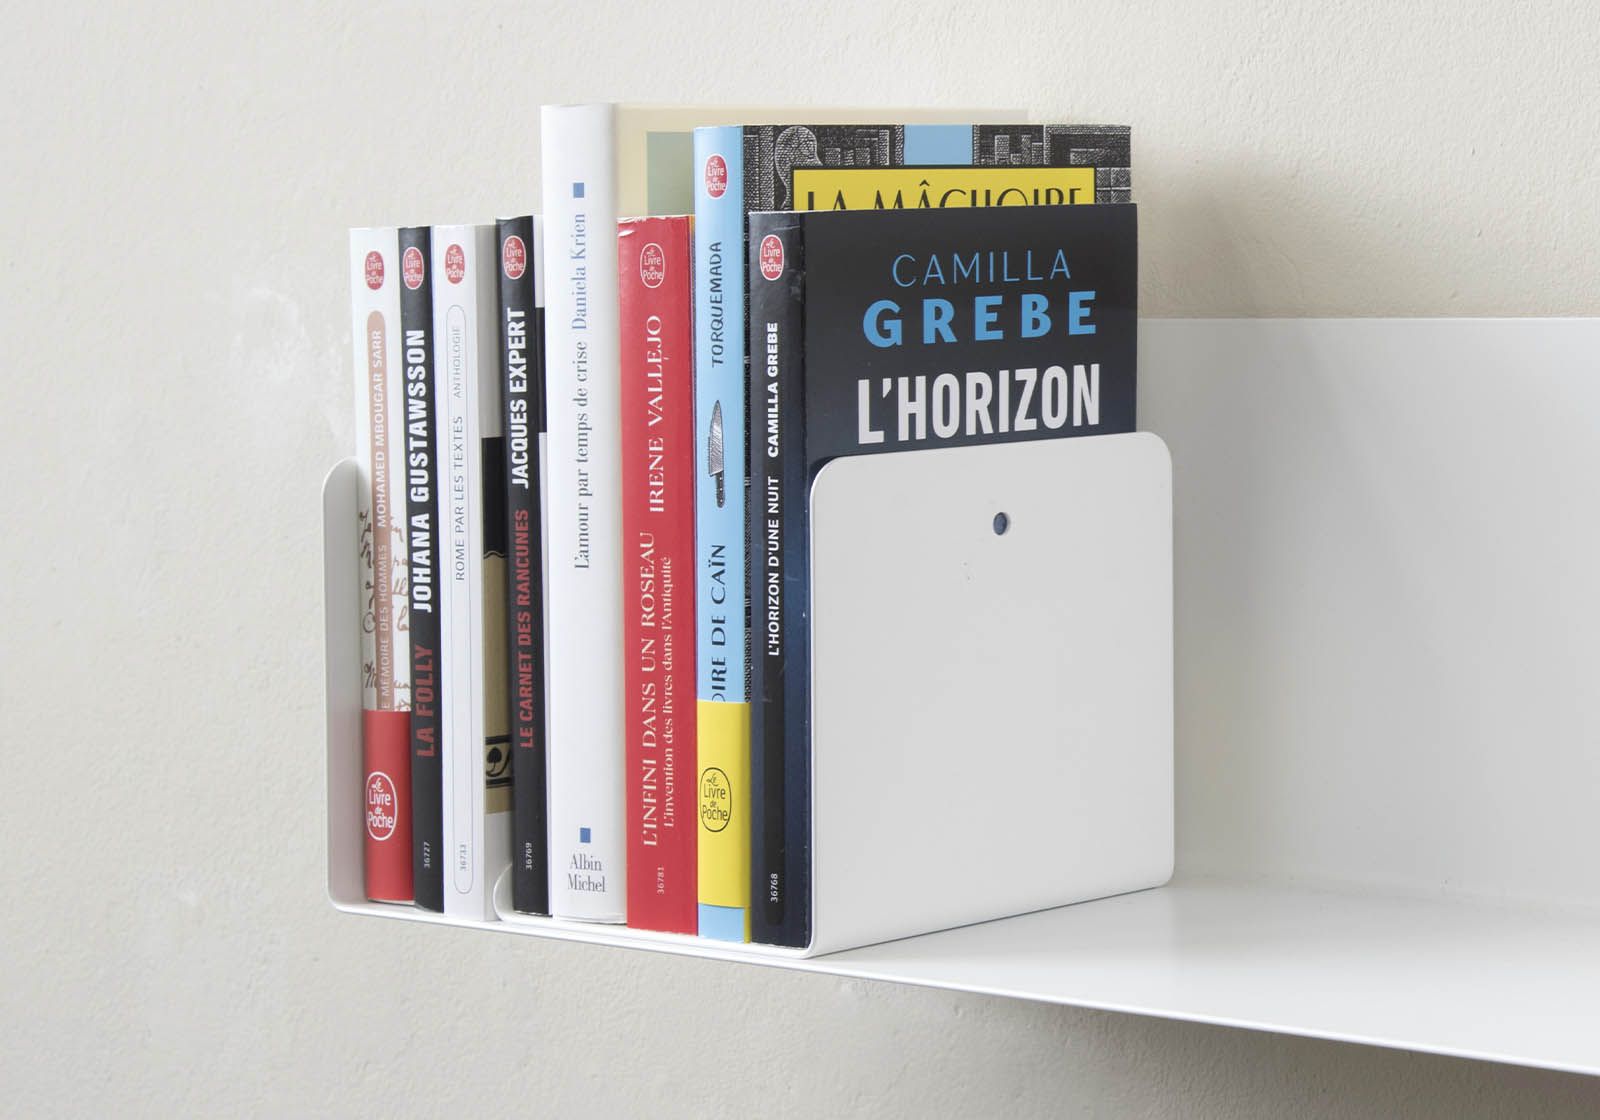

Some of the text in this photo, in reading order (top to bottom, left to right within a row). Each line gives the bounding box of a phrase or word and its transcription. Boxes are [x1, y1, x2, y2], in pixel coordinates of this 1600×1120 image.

[707, 181, 726, 192] Poche
[708, 166, 725, 177] Livre
[504, 261, 525, 272] Poche
[506, 247, 522, 257] Livre
[643, 256, 661, 265] Livre
[761, 262, 783, 272] Poche
[763, 247, 781, 258] Livre
[892, 248, 1071, 288] CAMILLA
[570, 213, 588, 330] Daniela Krien
[642, 269, 663, 280] Poche
[709, 241, 724, 368] TORQUEMADA
[863, 290, 1096, 348] GREBE
[451, 325, 462, 399] ANTHOLOGIE
[506, 307, 529, 490] JACQUES EXPERT
[767, 322, 779, 458] CAMILLA GREBE
[857, 363, 1100, 445] L'HORIZON
[372, 330, 387, 528] MOHAMED MBOUGAR SARR
[646, 315, 665, 512] IRENE VALLEJO
[406, 330, 432, 613] JOHANA GUSTAWSSON
[572, 341, 593, 569] L'amour par temps de crise
[453, 416, 465, 581] ROME PAR LES TEXTES
[378, 544, 388, 602] HOMMES
[708, 544, 726, 605] CAÏN
[768, 476, 780, 656] L'HORIZON D'UNE NUIT
[379, 606, 389, 631] DES
[514, 509, 534, 748] LE CARNET DES RANCUNES
[711, 615, 726, 647] DE
[661, 634, 673, 672] dans
[415, 645, 436, 757] LA FOLLY
[639, 531, 657, 846] L'INFINI DANS UN ROSEAU
[662, 676, 673, 713] livres
[662, 718, 673, 744] des
[368, 789, 391, 806] Livre
[663, 747, 674, 828] L'invention
[703, 786, 726, 800] Livre
[367, 811, 394, 829] Poche
[702, 805, 728, 822] Poche
[525, 842, 533, 871] 36769
[569, 853, 602, 871] Albin
[567, 873, 607, 893] Michel
[656, 866, 665, 895] 36781
[770, 873, 779, 903] 36768
